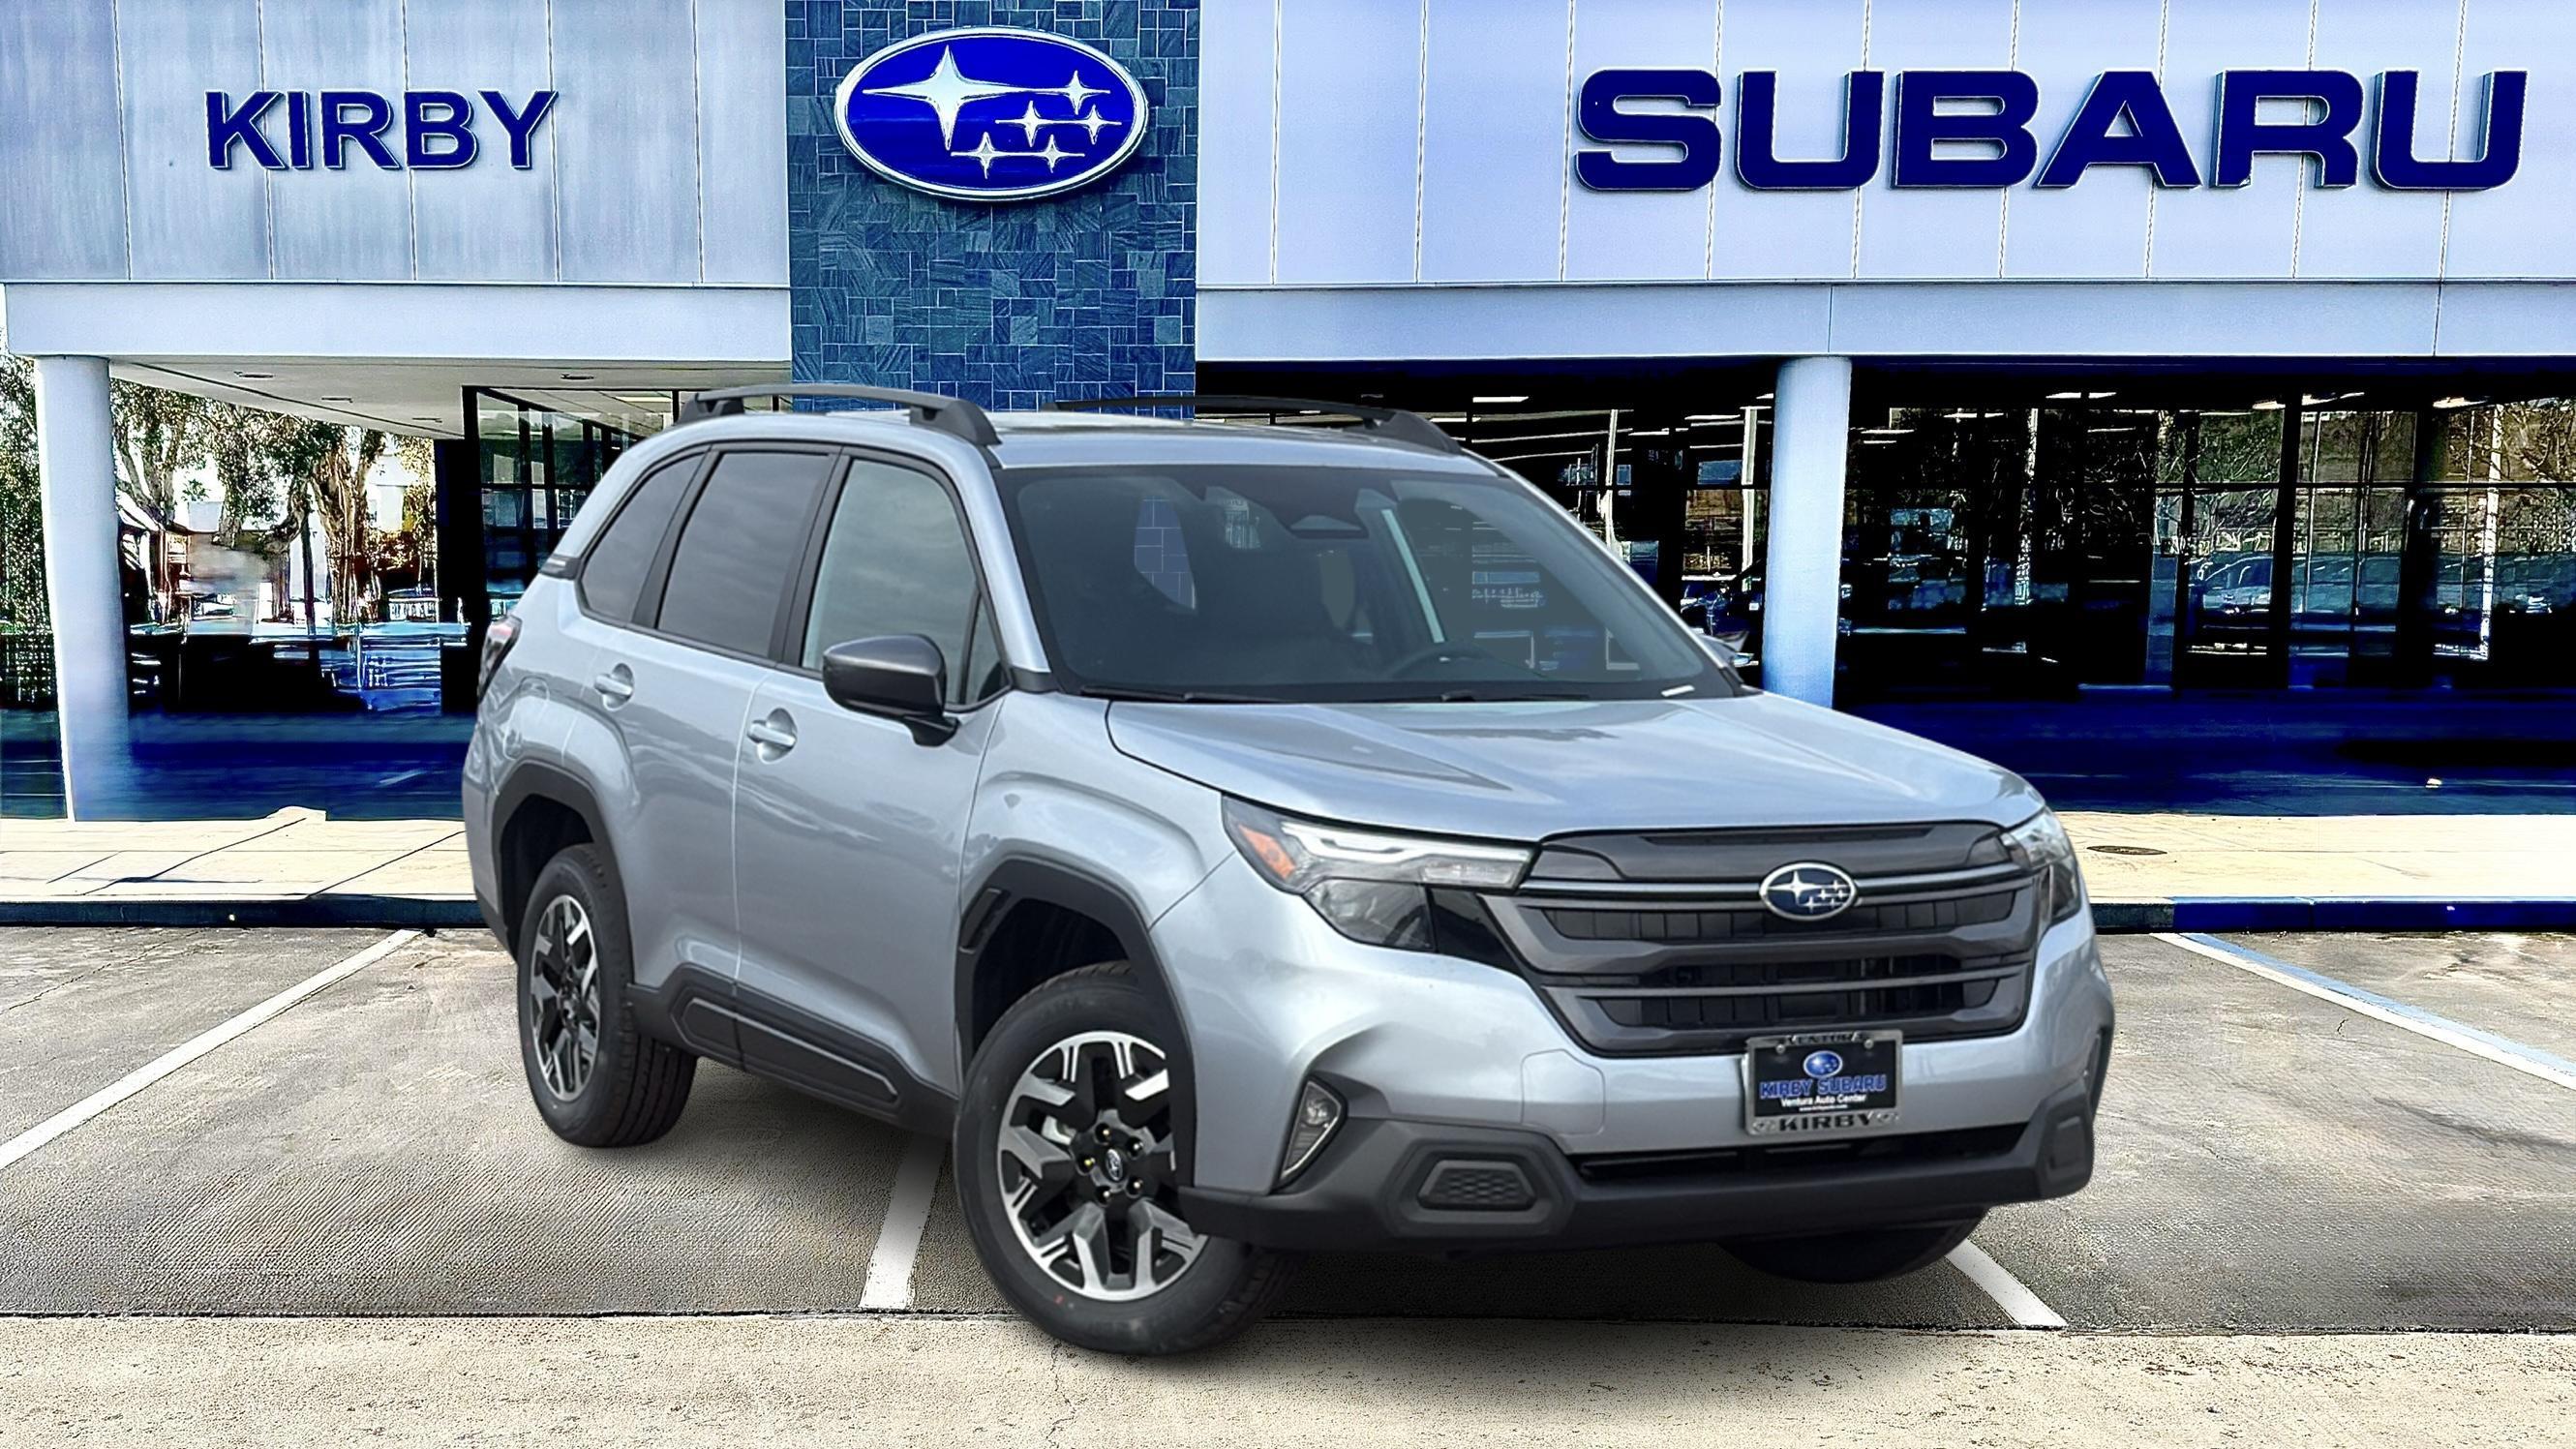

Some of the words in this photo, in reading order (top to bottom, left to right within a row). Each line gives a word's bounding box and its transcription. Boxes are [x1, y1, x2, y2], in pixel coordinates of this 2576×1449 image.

[204, 91, 559, 169] KIRBY
[1574, 70, 2526, 192] SUBARU
[1760, 1080, 1812, 1099] KIRBY
[1818, 1074, 1886, 1095] SUBARU
[1781, 1096, 1813, 1107] Ventura
[1814, 1095, 1835, 1105] Auto
[1837, 1093, 1866, 1103] Center
[1779, 1113, 1873, 1132] KIRBY
